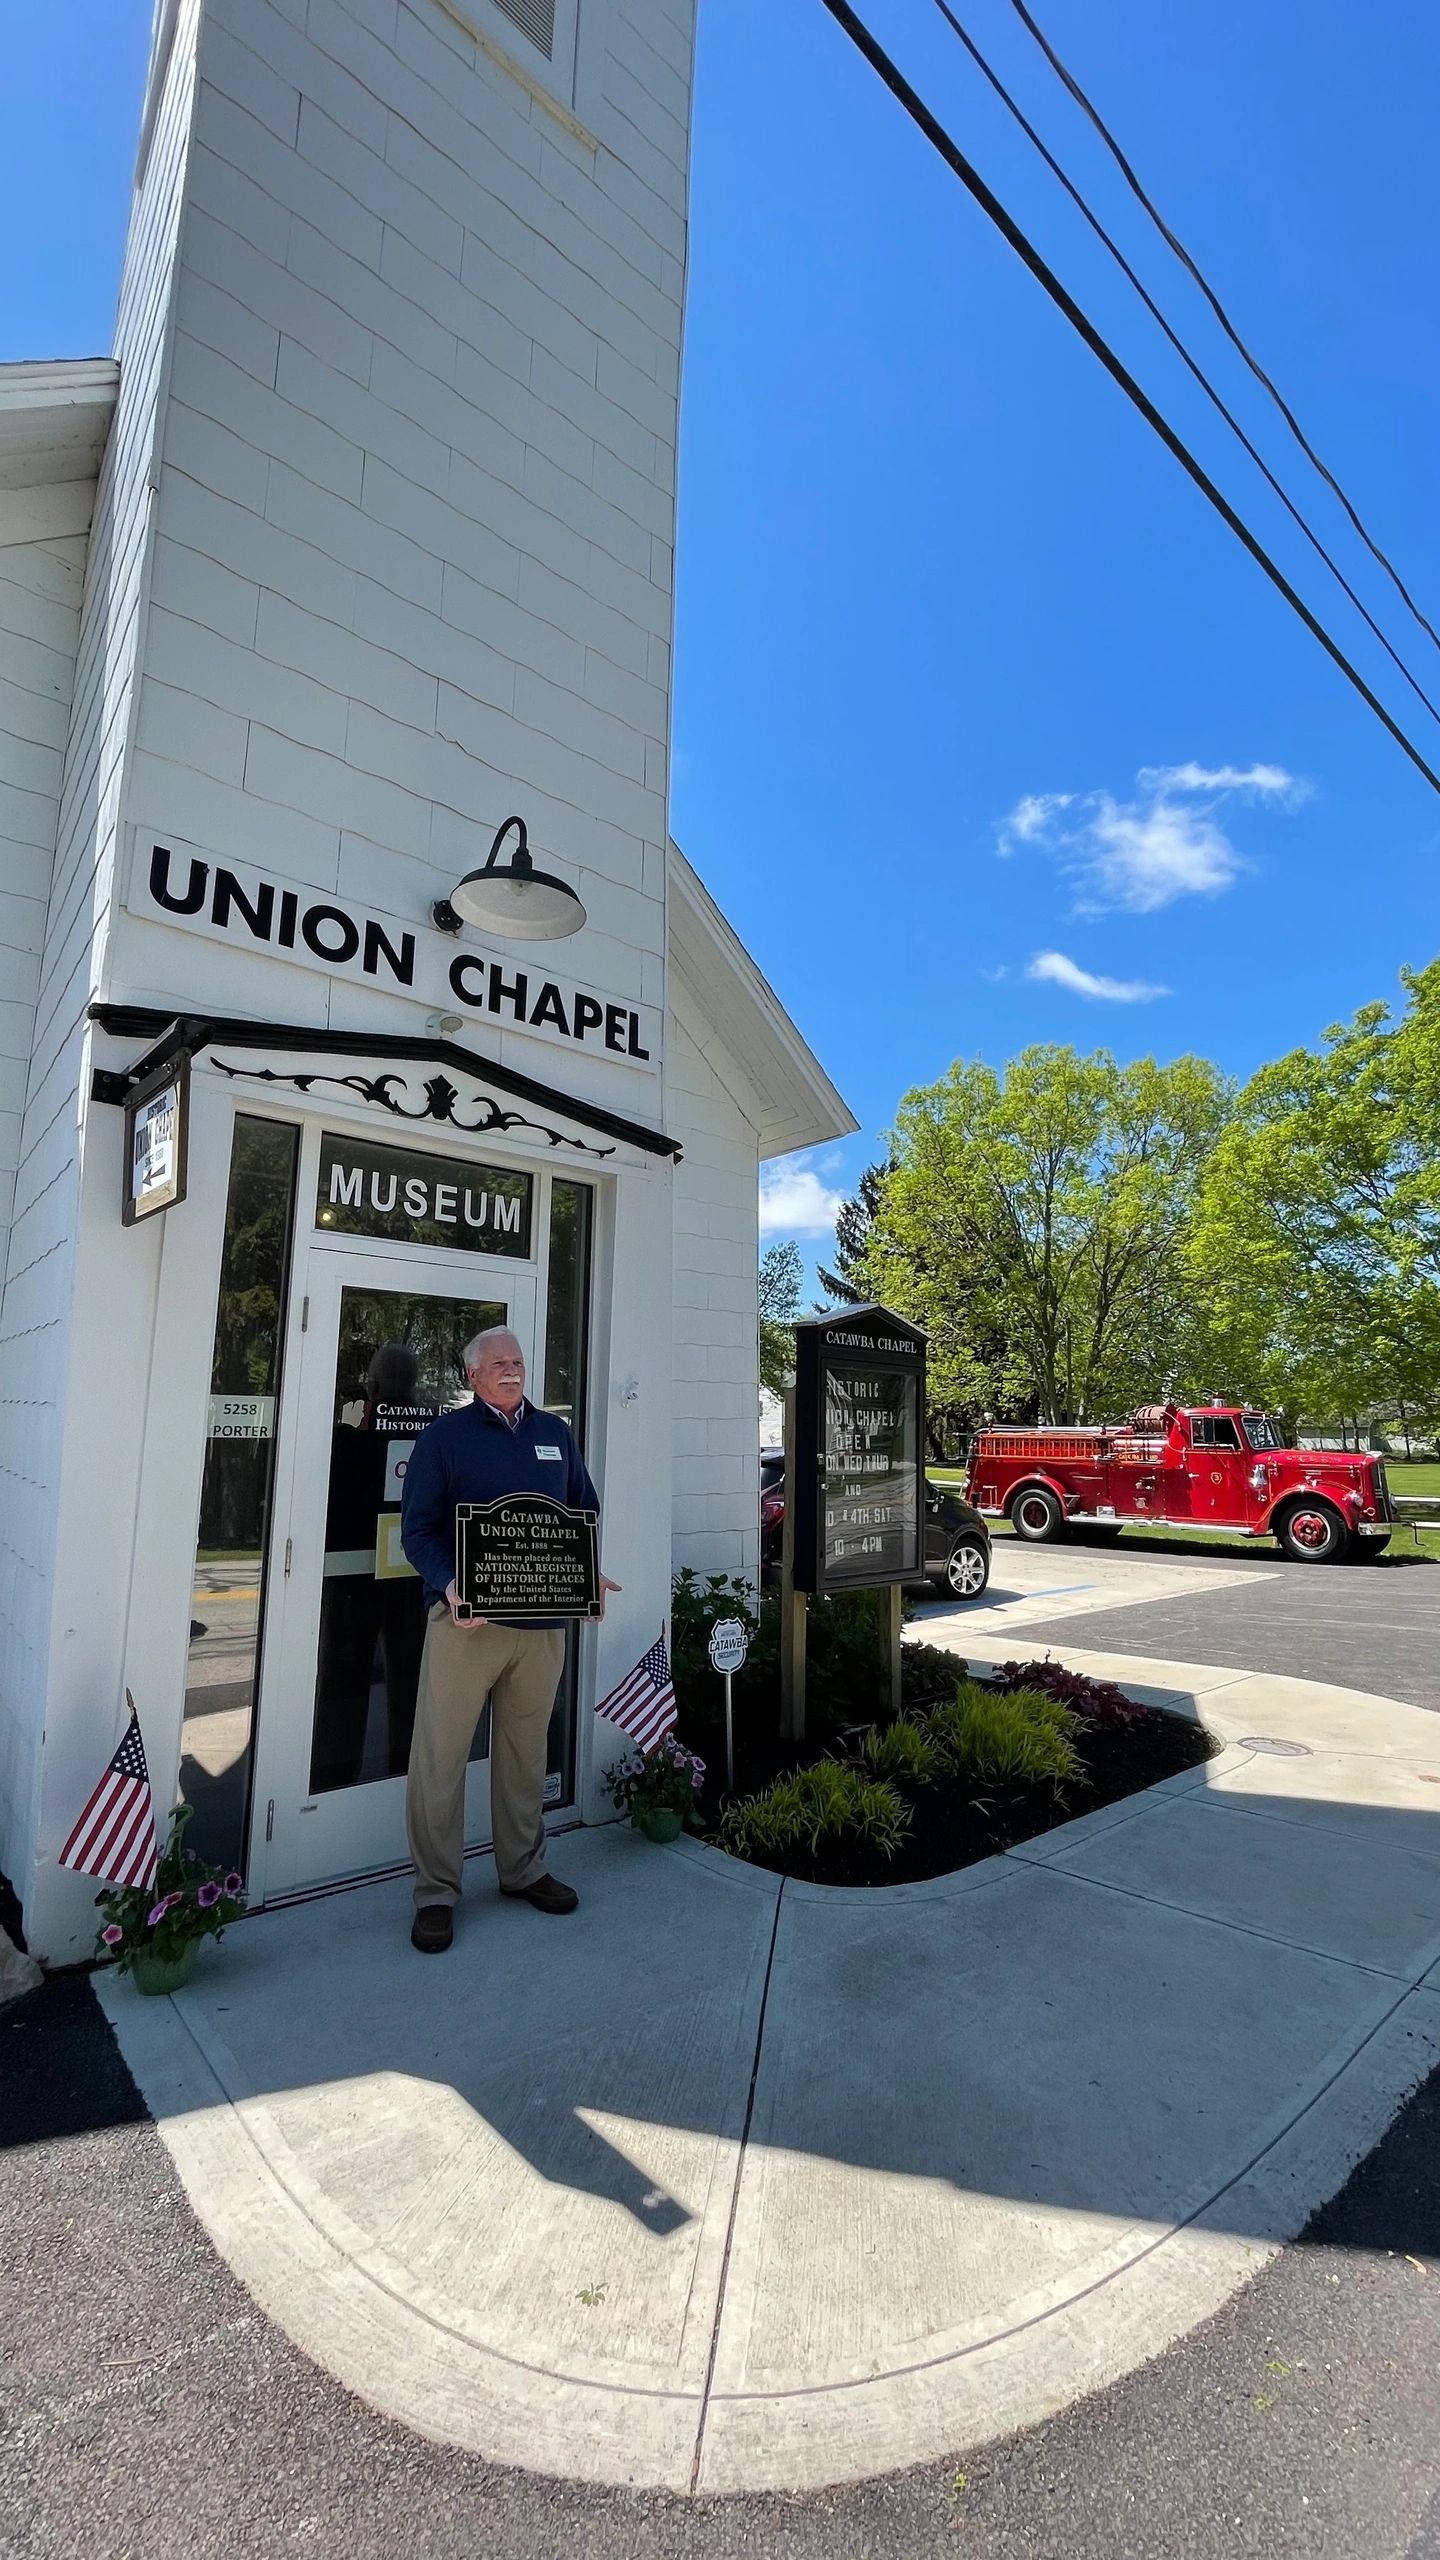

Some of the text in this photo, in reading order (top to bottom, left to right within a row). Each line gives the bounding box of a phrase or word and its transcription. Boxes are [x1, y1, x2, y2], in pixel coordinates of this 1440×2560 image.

[149, 845, 650, 1061] UNION CHAPEL
[329, 1164, 521, 1234] MUSEUM
[826, 1331, 917, 1354] CATAWBA CHAPEL
[223, 1403, 257, 1416] 5258
[376, 1403, 433, 1416] CATAWBA
[856, 1410, 894, 1427] CHAPEL
[213, 1425, 268, 1437] PORTER
[836, 1434, 870, 1450] OPEN
[826, 1455, 839, 1471] ON
[845, 1484, 861, 1496] AND
[501, 1510, 560, 1525] CATAWBA
[480, 1523, 579, 1540] UNION CHAPEL
[515, 1542, 548, 1550] Est. 1888
[834, 1539, 844, 1556] 10
[484, 1553, 501, 1561] Has
[503, 1553, 522, 1561] been
[524, 1554, 550, 1563] placed
[475, 1562, 584, 1573] NATIONAL REGISTER
[475, 1574, 585, 1583] OF HISTORIC PLACES
[490, 1585, 572, 1595] by the United States
[477, 1595, 526, 1605] Department
[709, 1636, 748, 1652] CATAWBA
